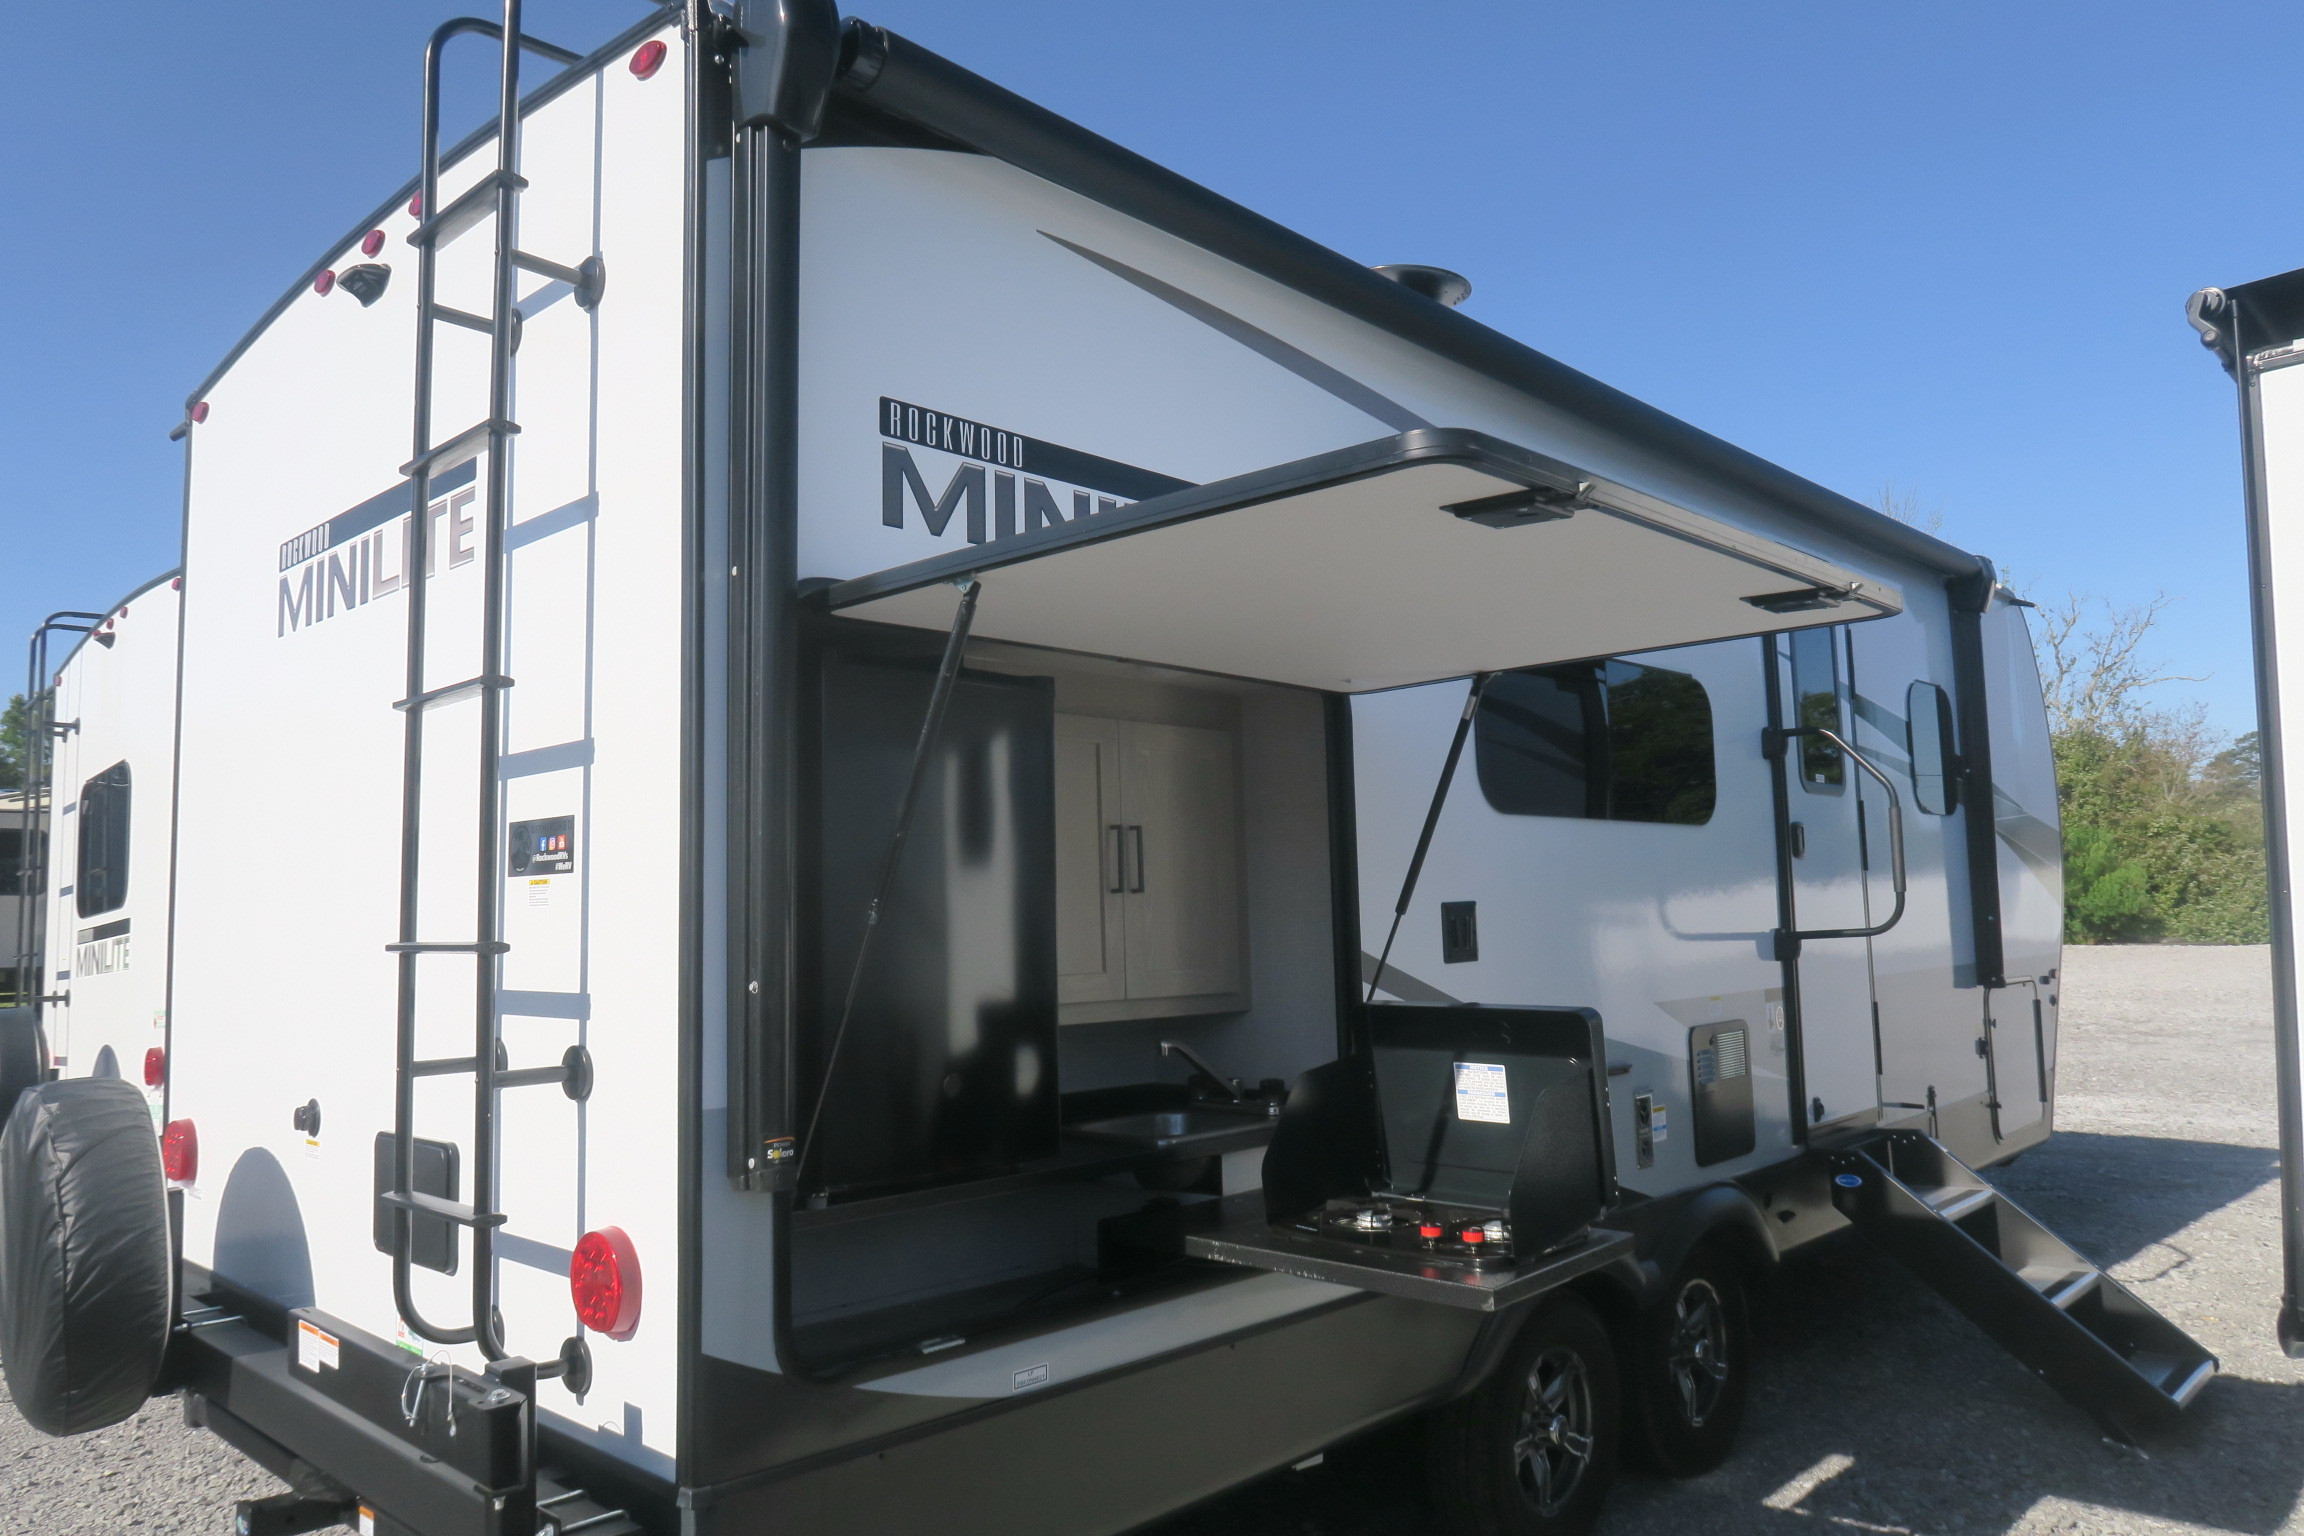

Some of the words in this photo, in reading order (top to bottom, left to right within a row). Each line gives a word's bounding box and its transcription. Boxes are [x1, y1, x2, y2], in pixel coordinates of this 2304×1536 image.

[890, 401, 1023, 468] ROCKWOOD
[278, 485, 476, 638] MINILITE
[76, 936, 131, 978] MINILITE
[767, 1148, 794, 1159] Solero
